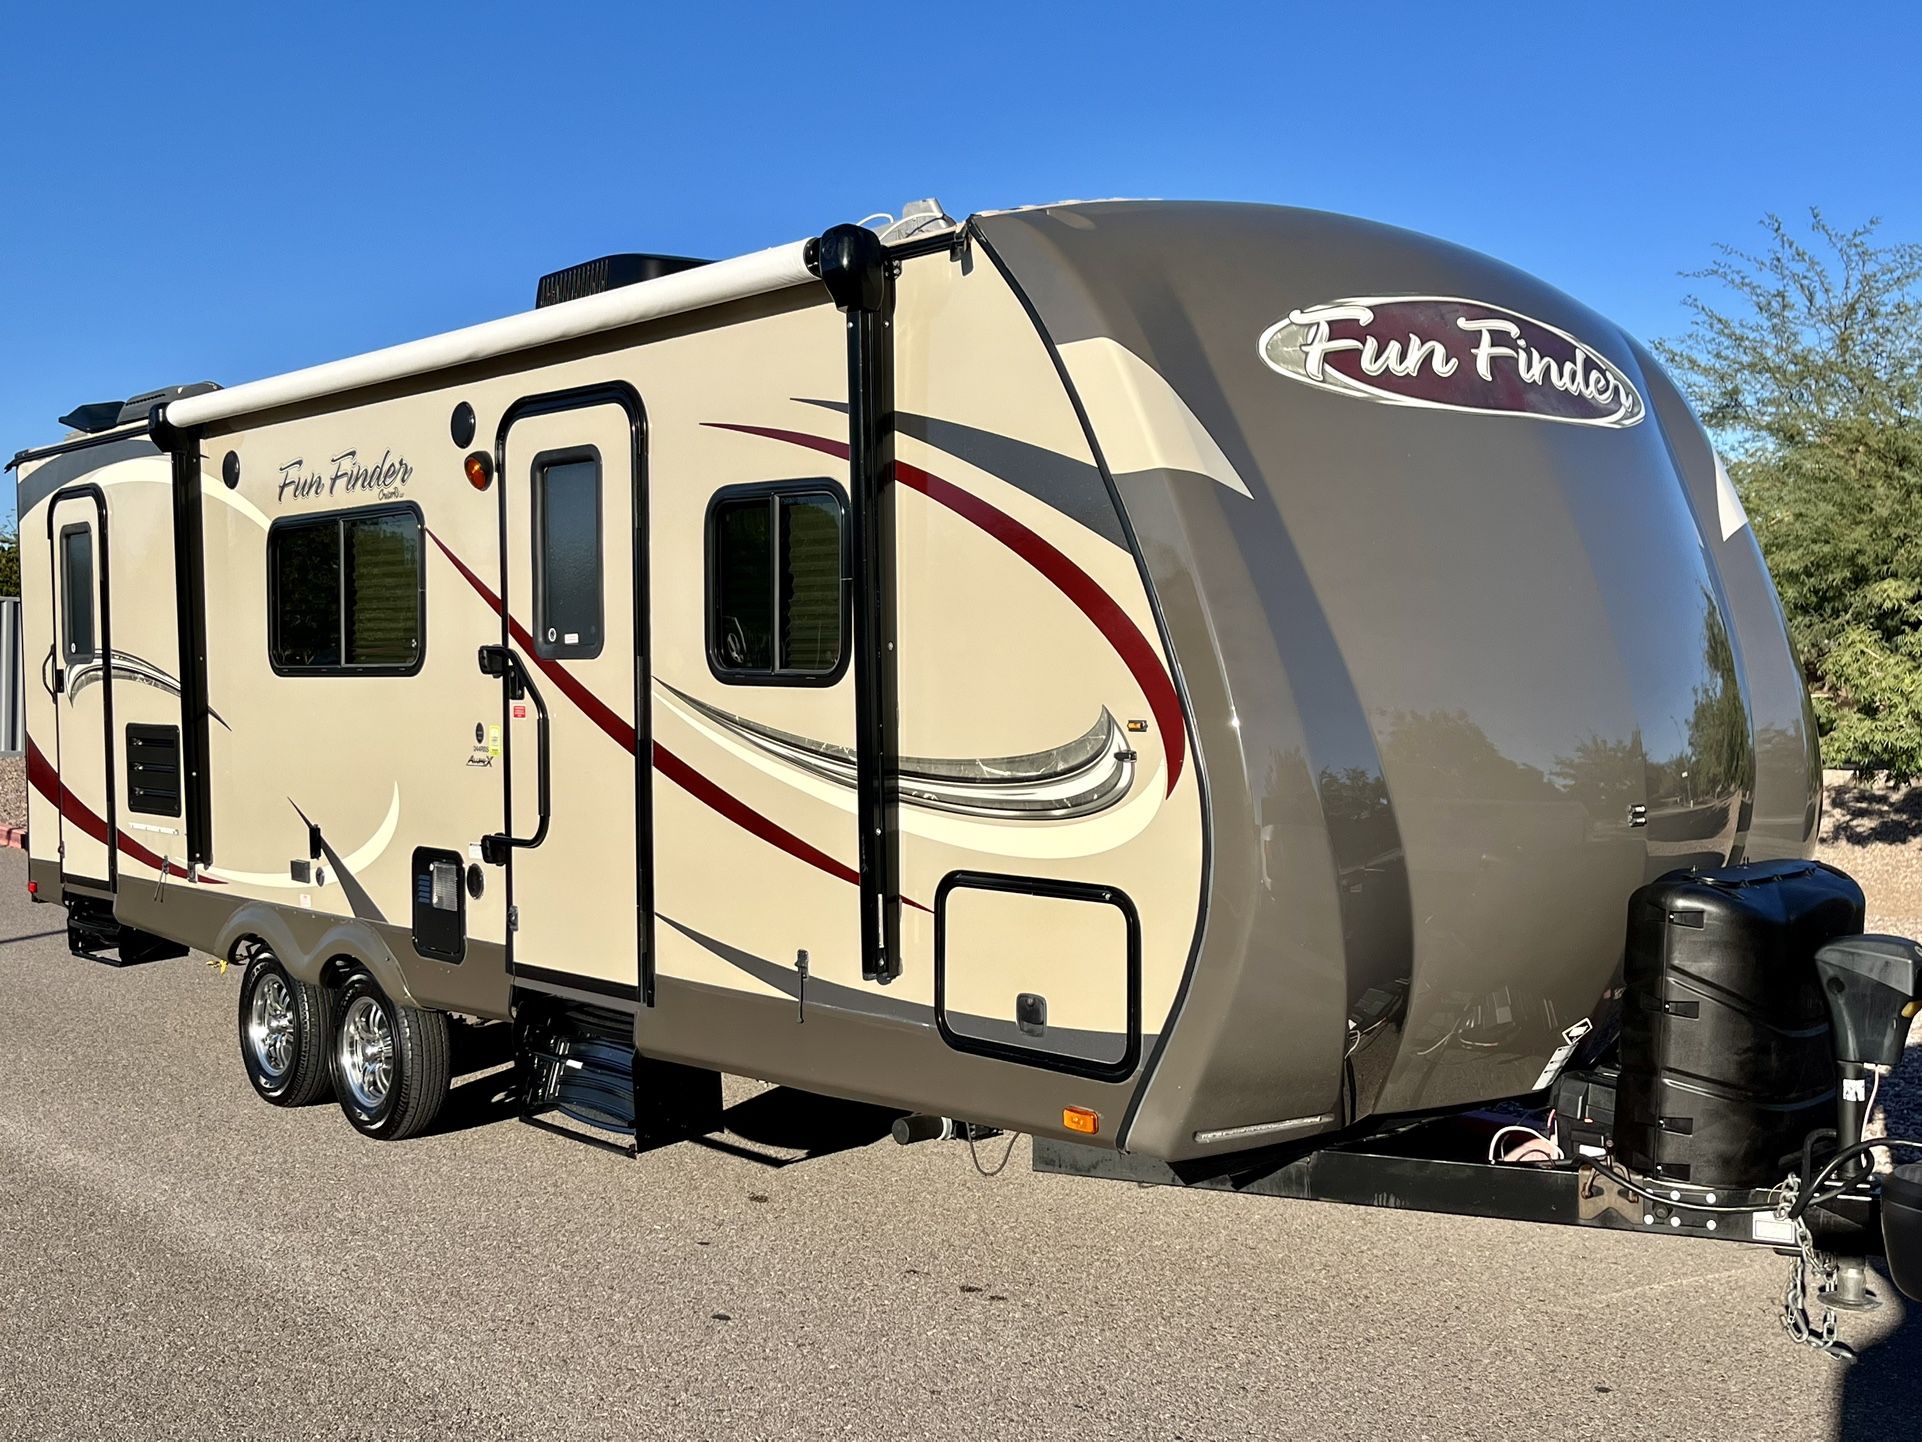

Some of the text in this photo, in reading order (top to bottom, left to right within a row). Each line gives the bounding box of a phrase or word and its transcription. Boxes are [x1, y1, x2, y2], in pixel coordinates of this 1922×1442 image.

[1288, 306, 1634, 412] Fun Finder
[279, 448, 413, 502] Fun Finder
